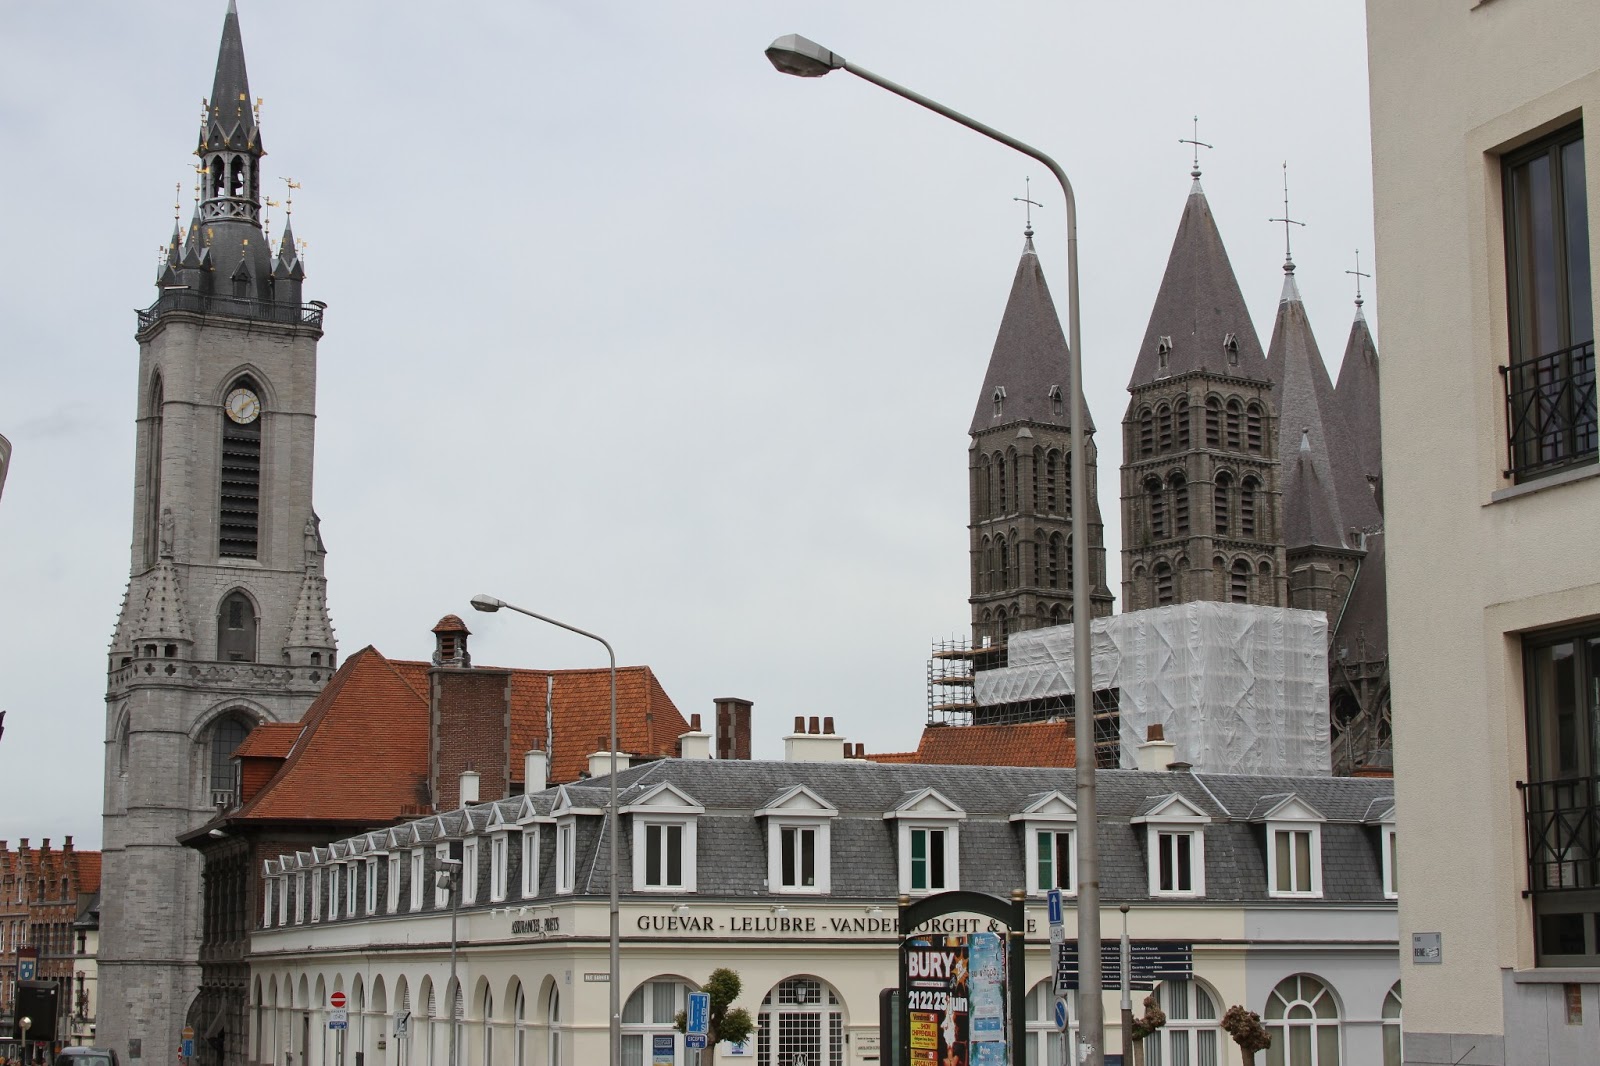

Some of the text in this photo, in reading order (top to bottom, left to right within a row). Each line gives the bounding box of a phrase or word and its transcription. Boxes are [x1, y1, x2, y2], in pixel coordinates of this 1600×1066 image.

[637, 914, 714, 932] GUEVAR
[730, 916, 816, 933] LELUBRE
[830, 917, 980, 934] VANDEORGHT
[908, 951, 955, 978] BURY
[908, 991, 919, 1009] 21
[920, 991, 933, 1010] 22
[933, 992, 947, 1011] 23
[948, 992, 968, 1012] juin
